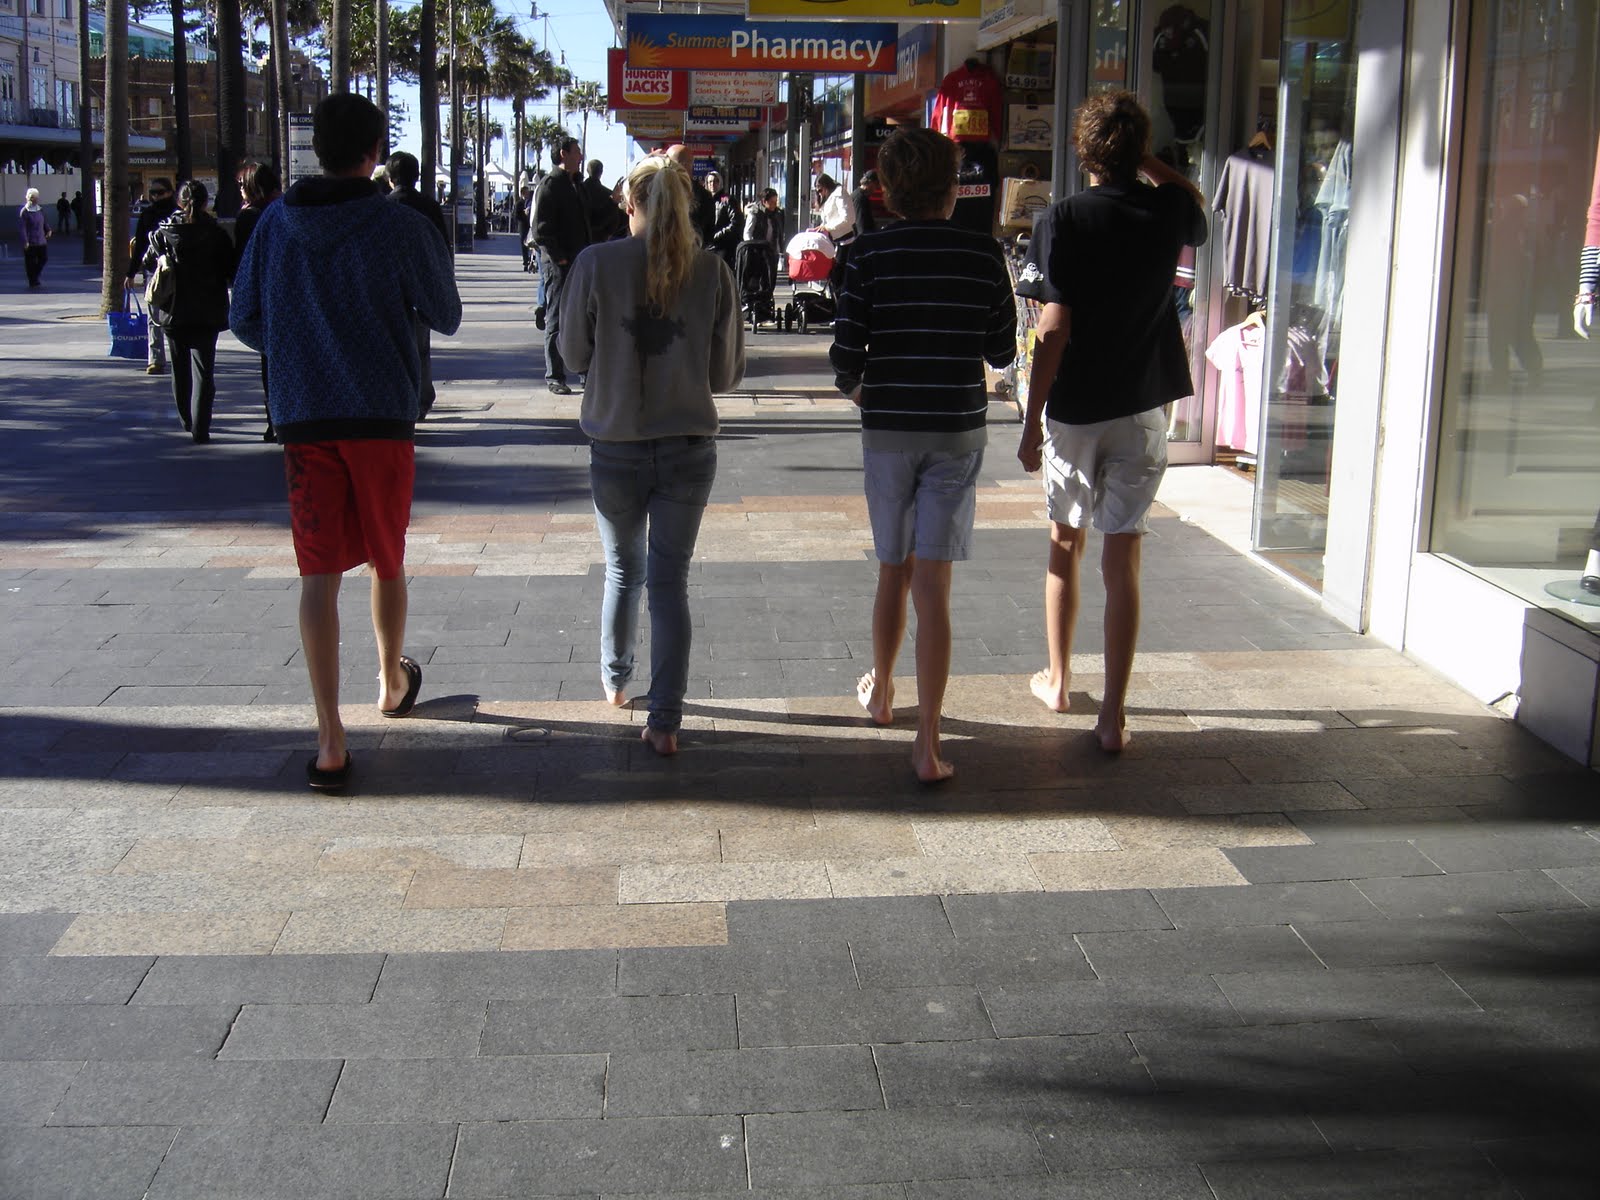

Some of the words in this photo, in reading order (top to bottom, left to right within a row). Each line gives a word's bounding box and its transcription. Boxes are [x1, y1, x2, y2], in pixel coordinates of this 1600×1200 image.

[731, 30, 883, 67] Pharmacy
[625, 70, 670, 80] HUNGRY
[625, 80, 670, 93] JACK'S
[1007, 75, 1038, 88] $4.99
[735, 88, 750, 96] Toys
[875, 129, 894, 137] UG
[957, 185, 989, 196] $6.99
